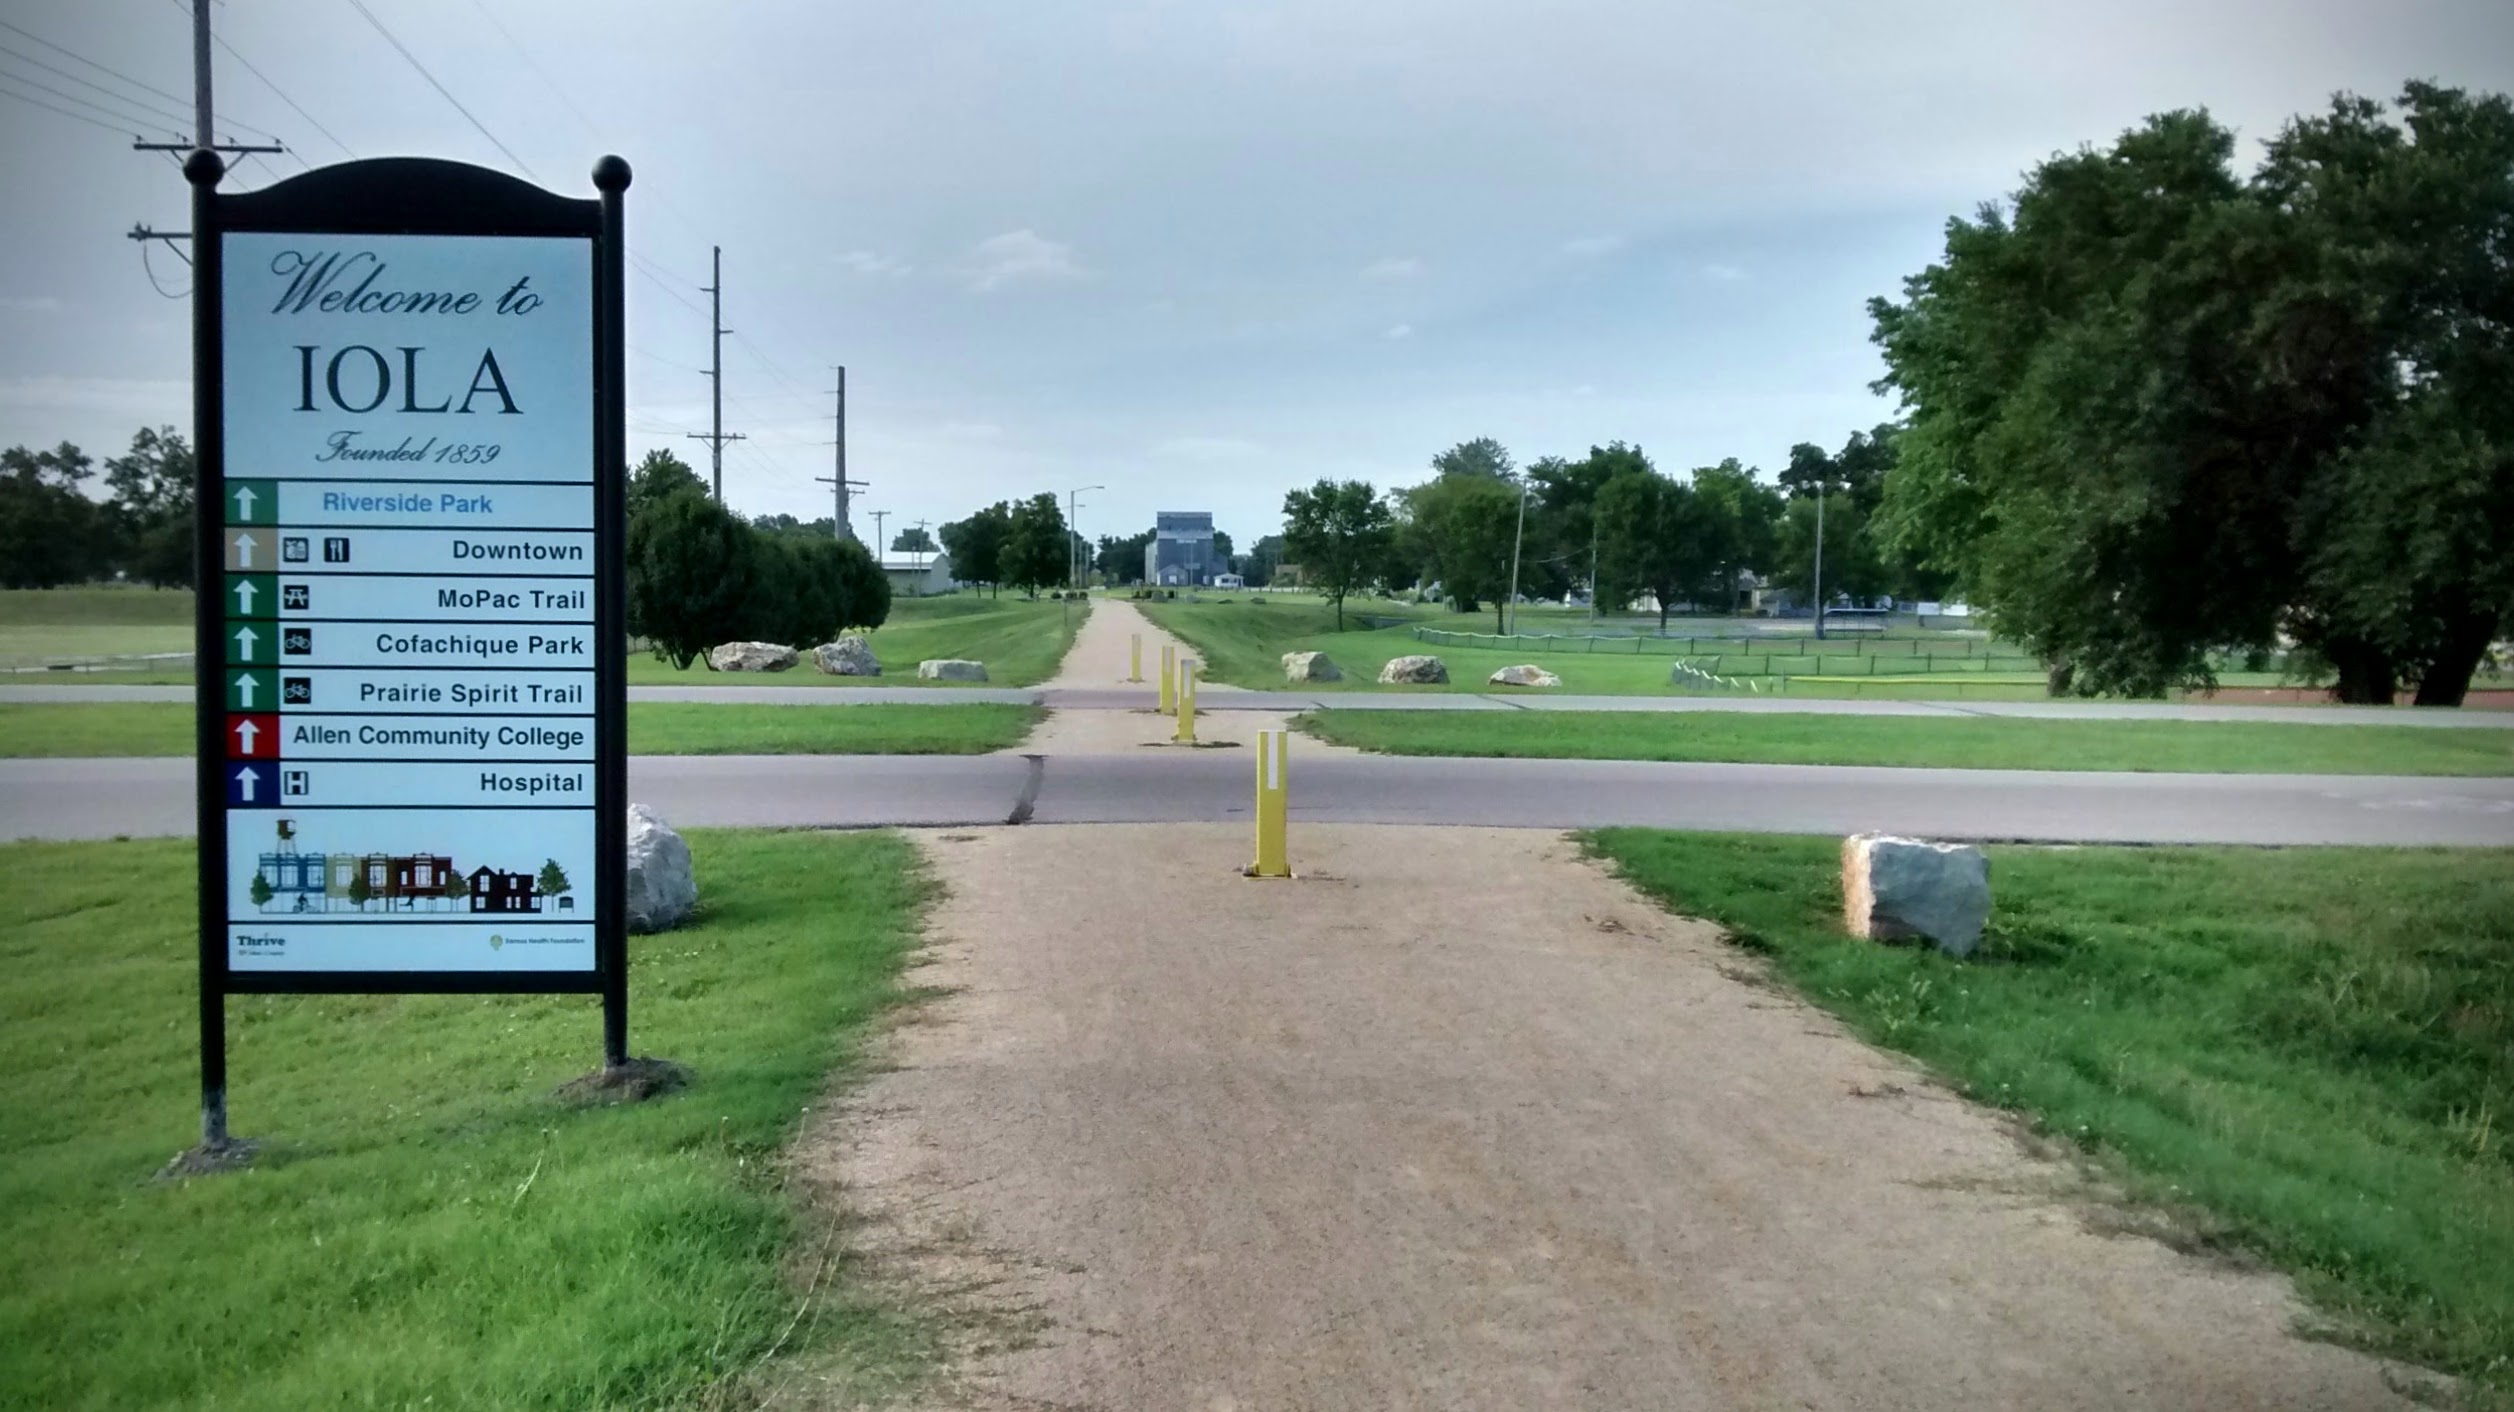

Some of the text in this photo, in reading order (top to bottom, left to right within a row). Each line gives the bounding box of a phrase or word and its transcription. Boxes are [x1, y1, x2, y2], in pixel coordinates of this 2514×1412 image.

[270, 250, 544, 315] Welcome to
[292, 345, 524, 414] IOLA
[315, 430, 501, 464] Founded 1859
[323, 492, 493, 513] Riverside Park
[452, 540, 584, 560] Downtown
[437, 589, 585, 609] MoPac Trail
[376, 634, 584, 658] Cofachique Park
[360, 683, 583, 707] Prairie Spirit Trail
[293, 726, 584, 750] Allen Community College
[287, 772, 305, 794] H
[481, 773, 583, 795] Hospital
[236, 932, 286, 946] Thrive
